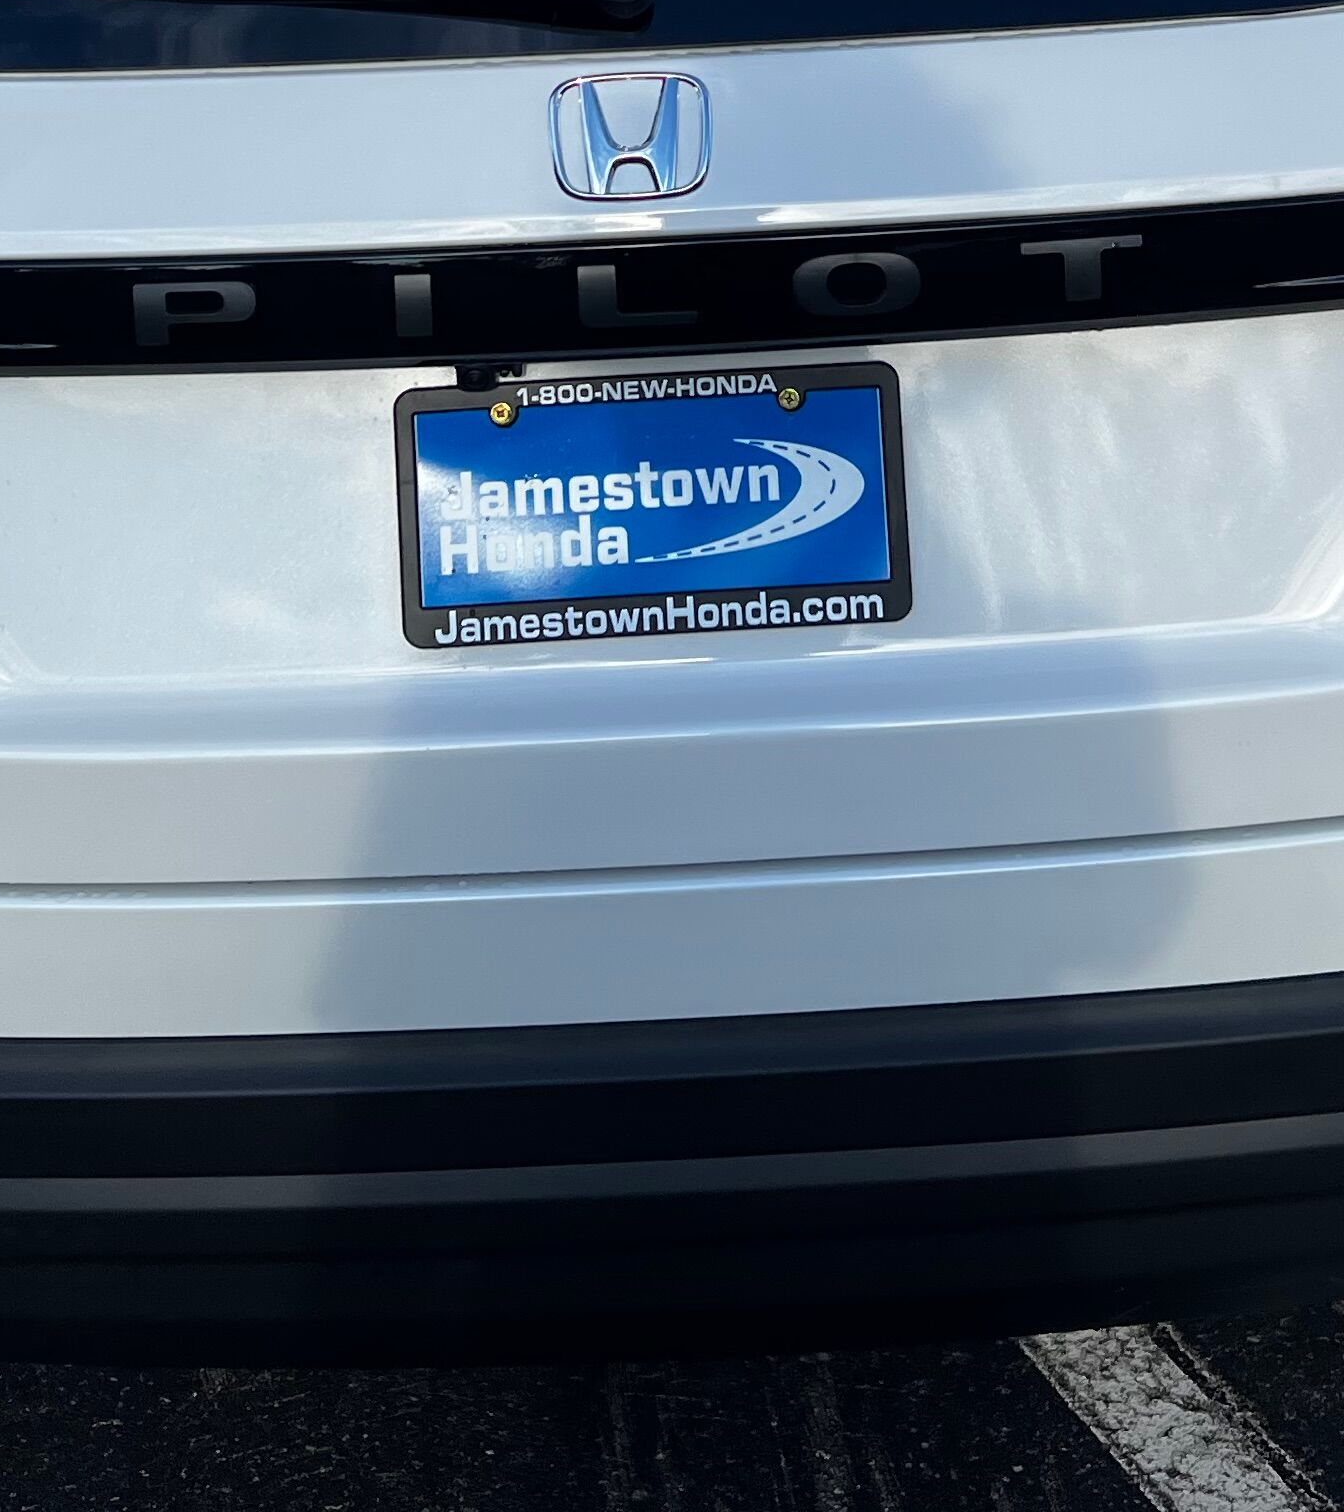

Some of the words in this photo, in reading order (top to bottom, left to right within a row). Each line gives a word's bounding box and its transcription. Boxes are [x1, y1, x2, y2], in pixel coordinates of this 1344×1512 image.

[131, 233, 1145, 347] PILOT
[516, 372, 778, 408] 1-800-NEW-HONDA
[439, 460, 782, 521] Jamestown
[438, 514, 630, 577] Honda
[433, 590, 885, 646] JamestownHonda.com
